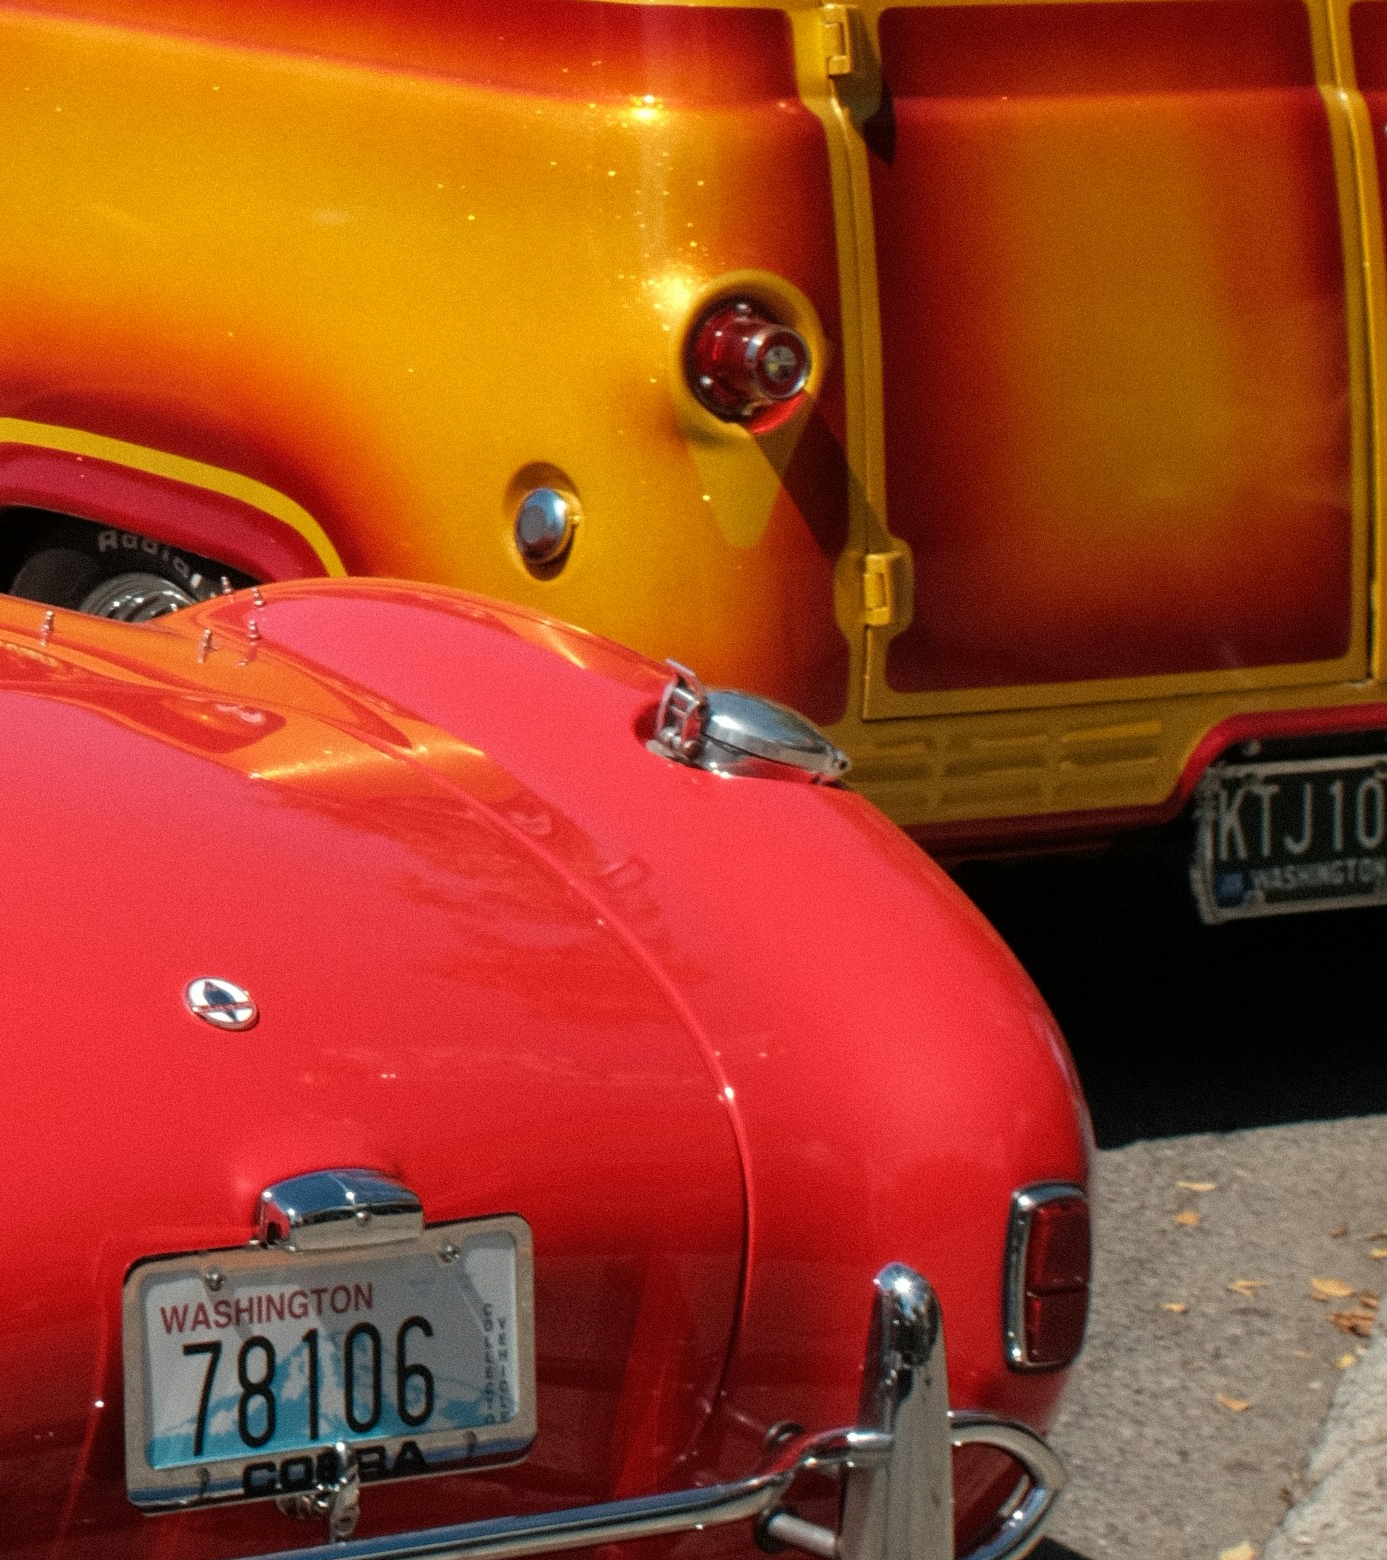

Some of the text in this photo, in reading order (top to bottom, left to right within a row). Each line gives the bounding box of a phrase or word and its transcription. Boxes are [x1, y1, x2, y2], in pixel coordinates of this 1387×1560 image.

[160, 1282, 374, 1335] WASHINGTON
[182, 1315, 435, 1457] 78106
[483, 1302, 496, 1425] COLLECTO
[242, 1440, 429, 1497] CORA
